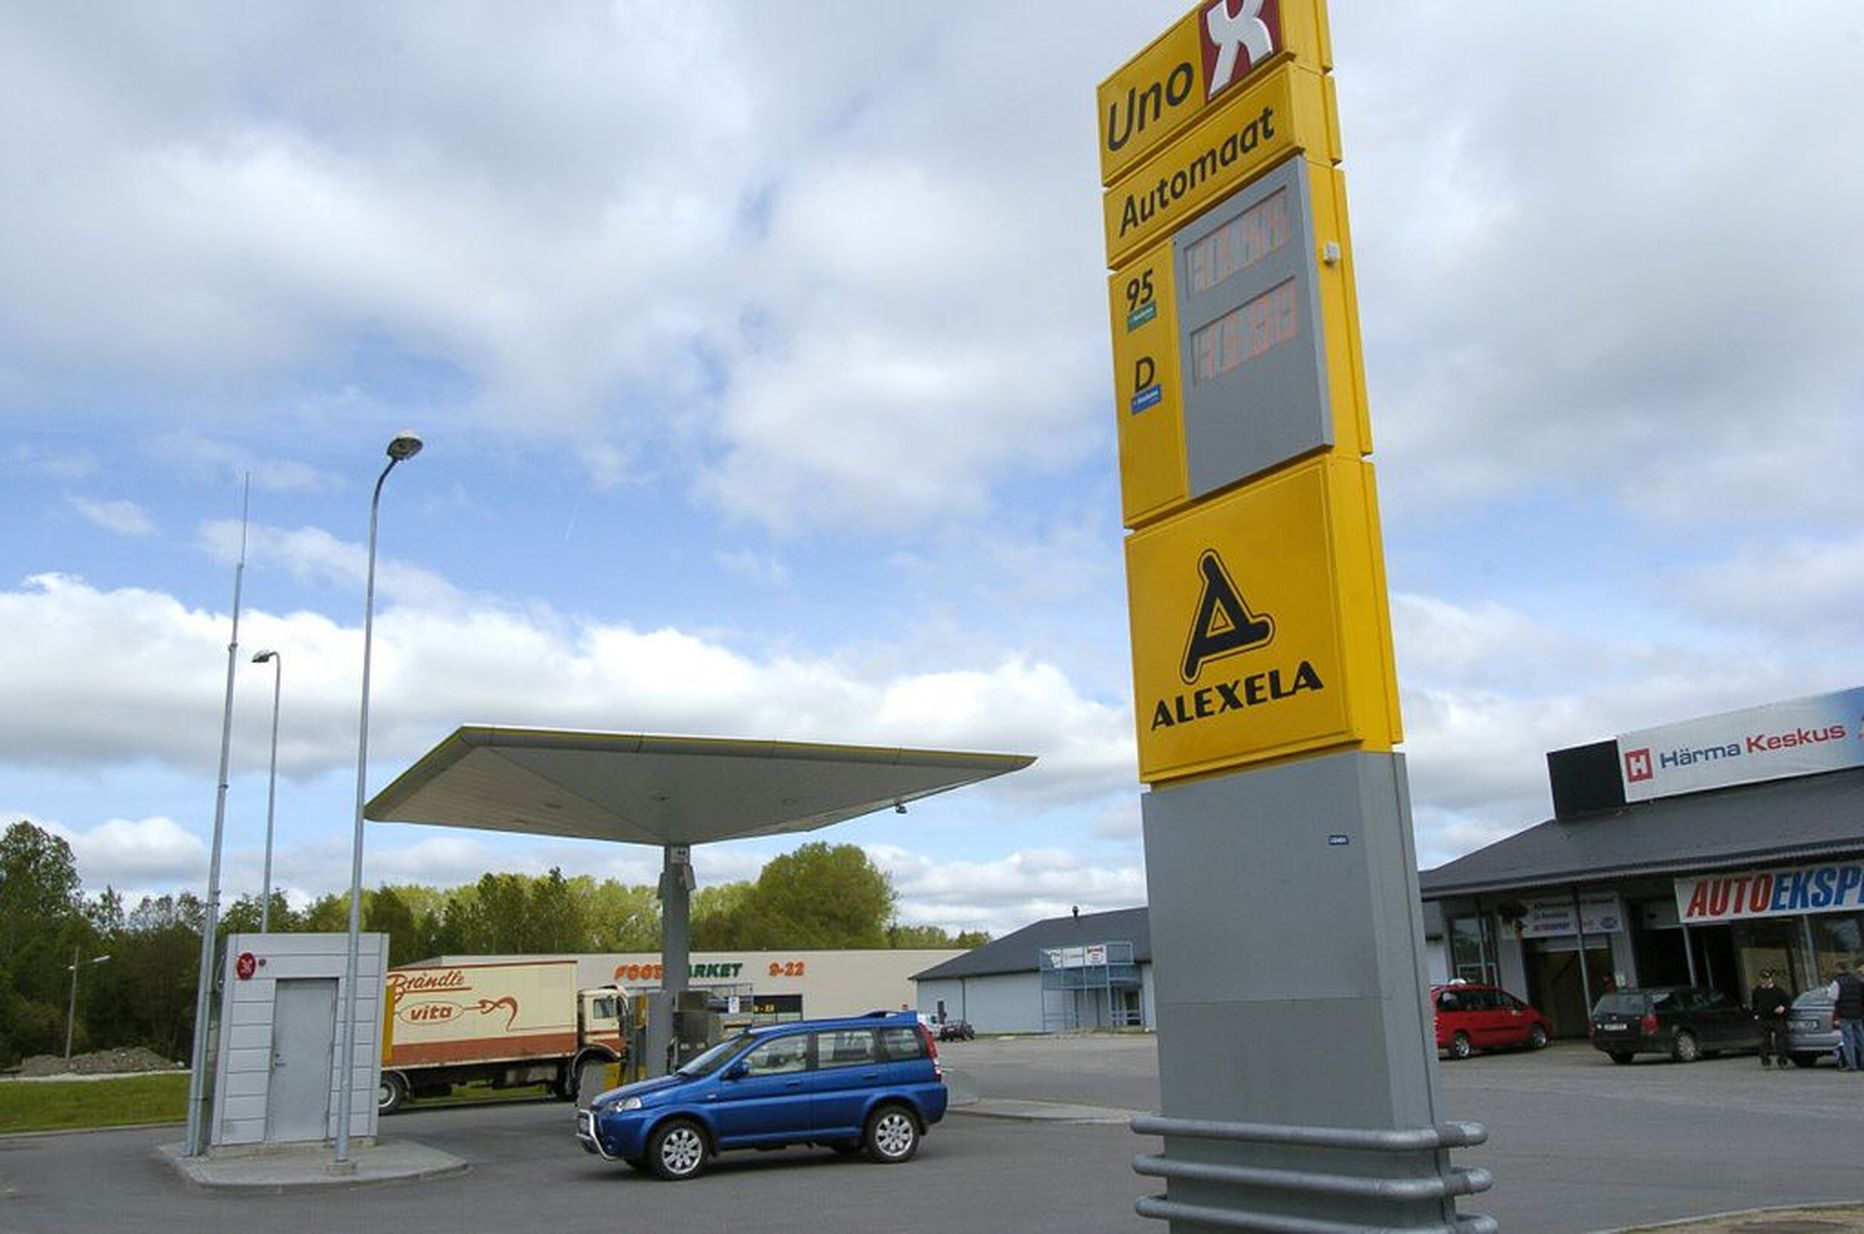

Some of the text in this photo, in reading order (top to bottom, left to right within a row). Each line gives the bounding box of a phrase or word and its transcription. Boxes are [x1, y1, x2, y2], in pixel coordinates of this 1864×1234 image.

[1107, 61, 1194, 152] Uno
[1119, 106, 1275, 238] Automaat
[1126, 268, 1154, 312] 95
[1134, 356, 1155, 394] D
[1150, 660, 1324, 731] ALEXELA
[1659, 725, 1847, 769] Härma Keskus
[1686, 864, 1864, 918] AUTOEKSP
[769, 961, 804, 977] 9-22
[410, 1005, 453, 1020] vita
